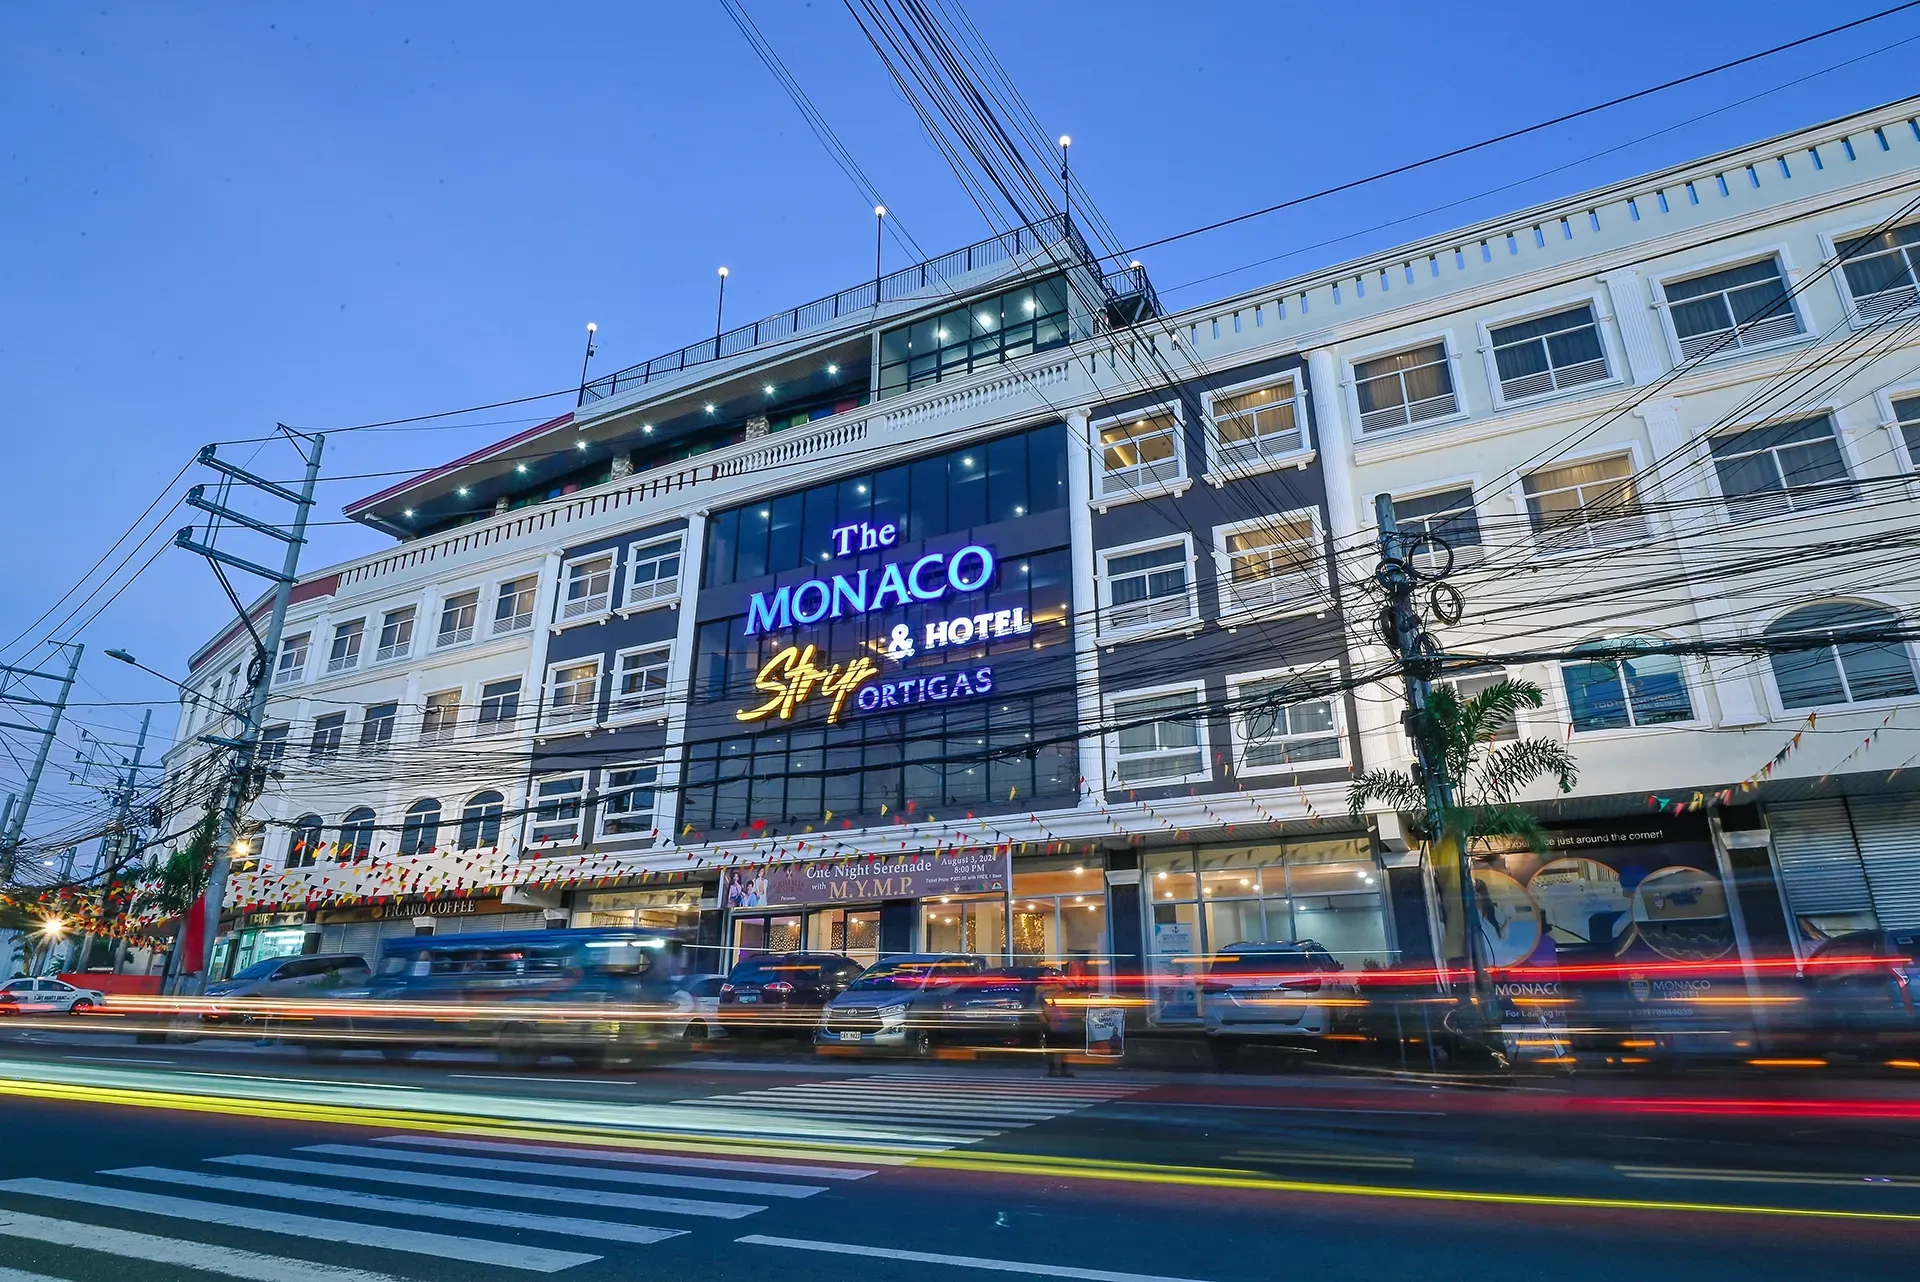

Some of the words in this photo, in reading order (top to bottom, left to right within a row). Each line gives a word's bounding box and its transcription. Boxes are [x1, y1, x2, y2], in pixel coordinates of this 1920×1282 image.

[832, 522, 896, 557] The
[743, 545, 994, 636] MONACO
[887, 624, 916, 661] &
[925, 607, 1032, 649] HOTEL
[735, 644, 880, 724] Strip
[858, 667, 994, 711] ORTIGAS
[1556, 837, 1574, 847] just
[1576, 835, 1609, 844] around
[1611, 833, 1627, 841] the
[1628, 830, 1664, 840] corner!
[806, 867, 831, 879] One
[834, 864, 869, 880] Night
[873, 859, 932, 875] Serenade
[941, 856, 968, 867] August
[970, 855, 977, 864] 3,
[979, 854, 997, 862] 2024
[954, 866, 970, 874] 8:00
[971, 864, 985, 872] PM
[811, 882, 827, 890] with
[829, 877, 915, 899] M.Y.M.P.
[385, 903, 427, 918] FIGARO
[430, 899, 476, 914] COFFEE
[1653, 980, 1711, 991] MONACO
[1505, 1010, 1520, 1018] For
